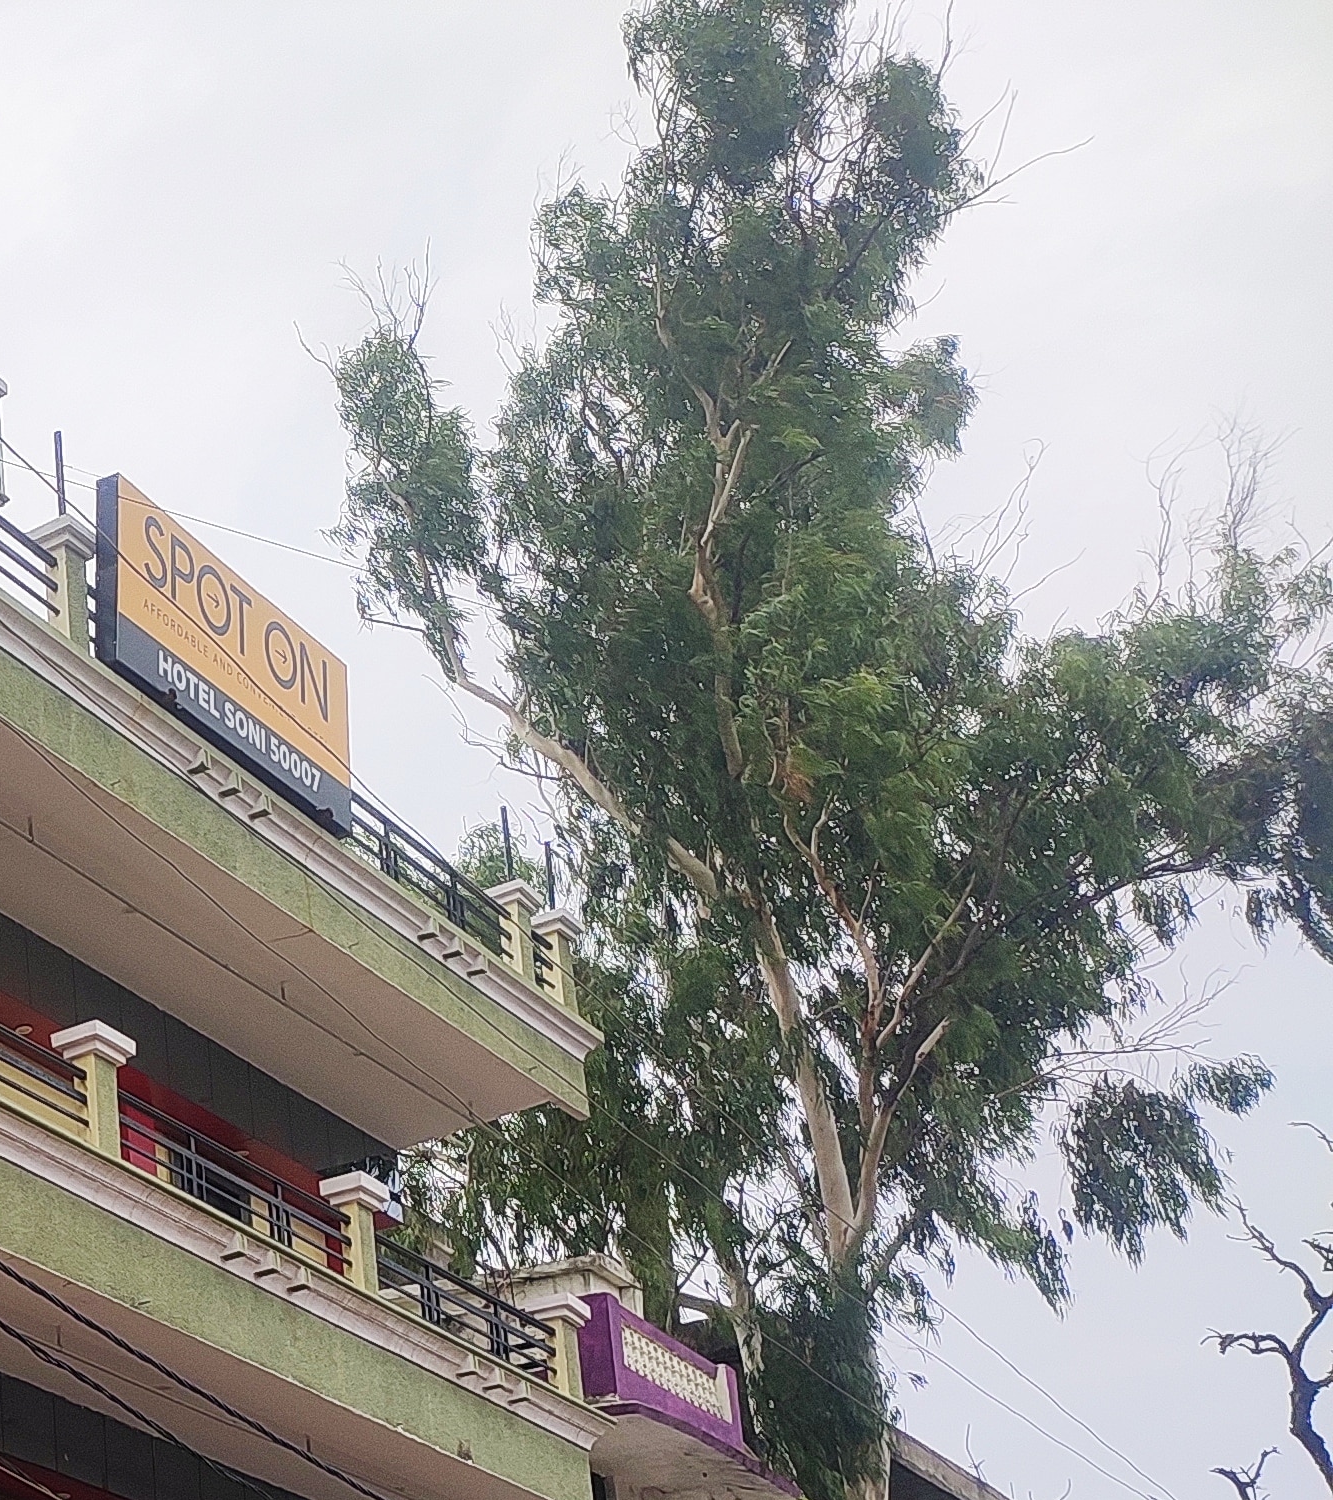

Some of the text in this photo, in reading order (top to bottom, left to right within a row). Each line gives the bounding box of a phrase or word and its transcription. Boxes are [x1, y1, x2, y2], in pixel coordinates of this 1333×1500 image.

[143, 598, 209, 658] AFFORDABLE
[144, 516, 252, 656] SPOT
[265, 621, 329, 723] ON
[158, 650, 221, 720] HOTEL
[223, 703, 267, 754] SONI
[269, 740, 321, 793] 50007
